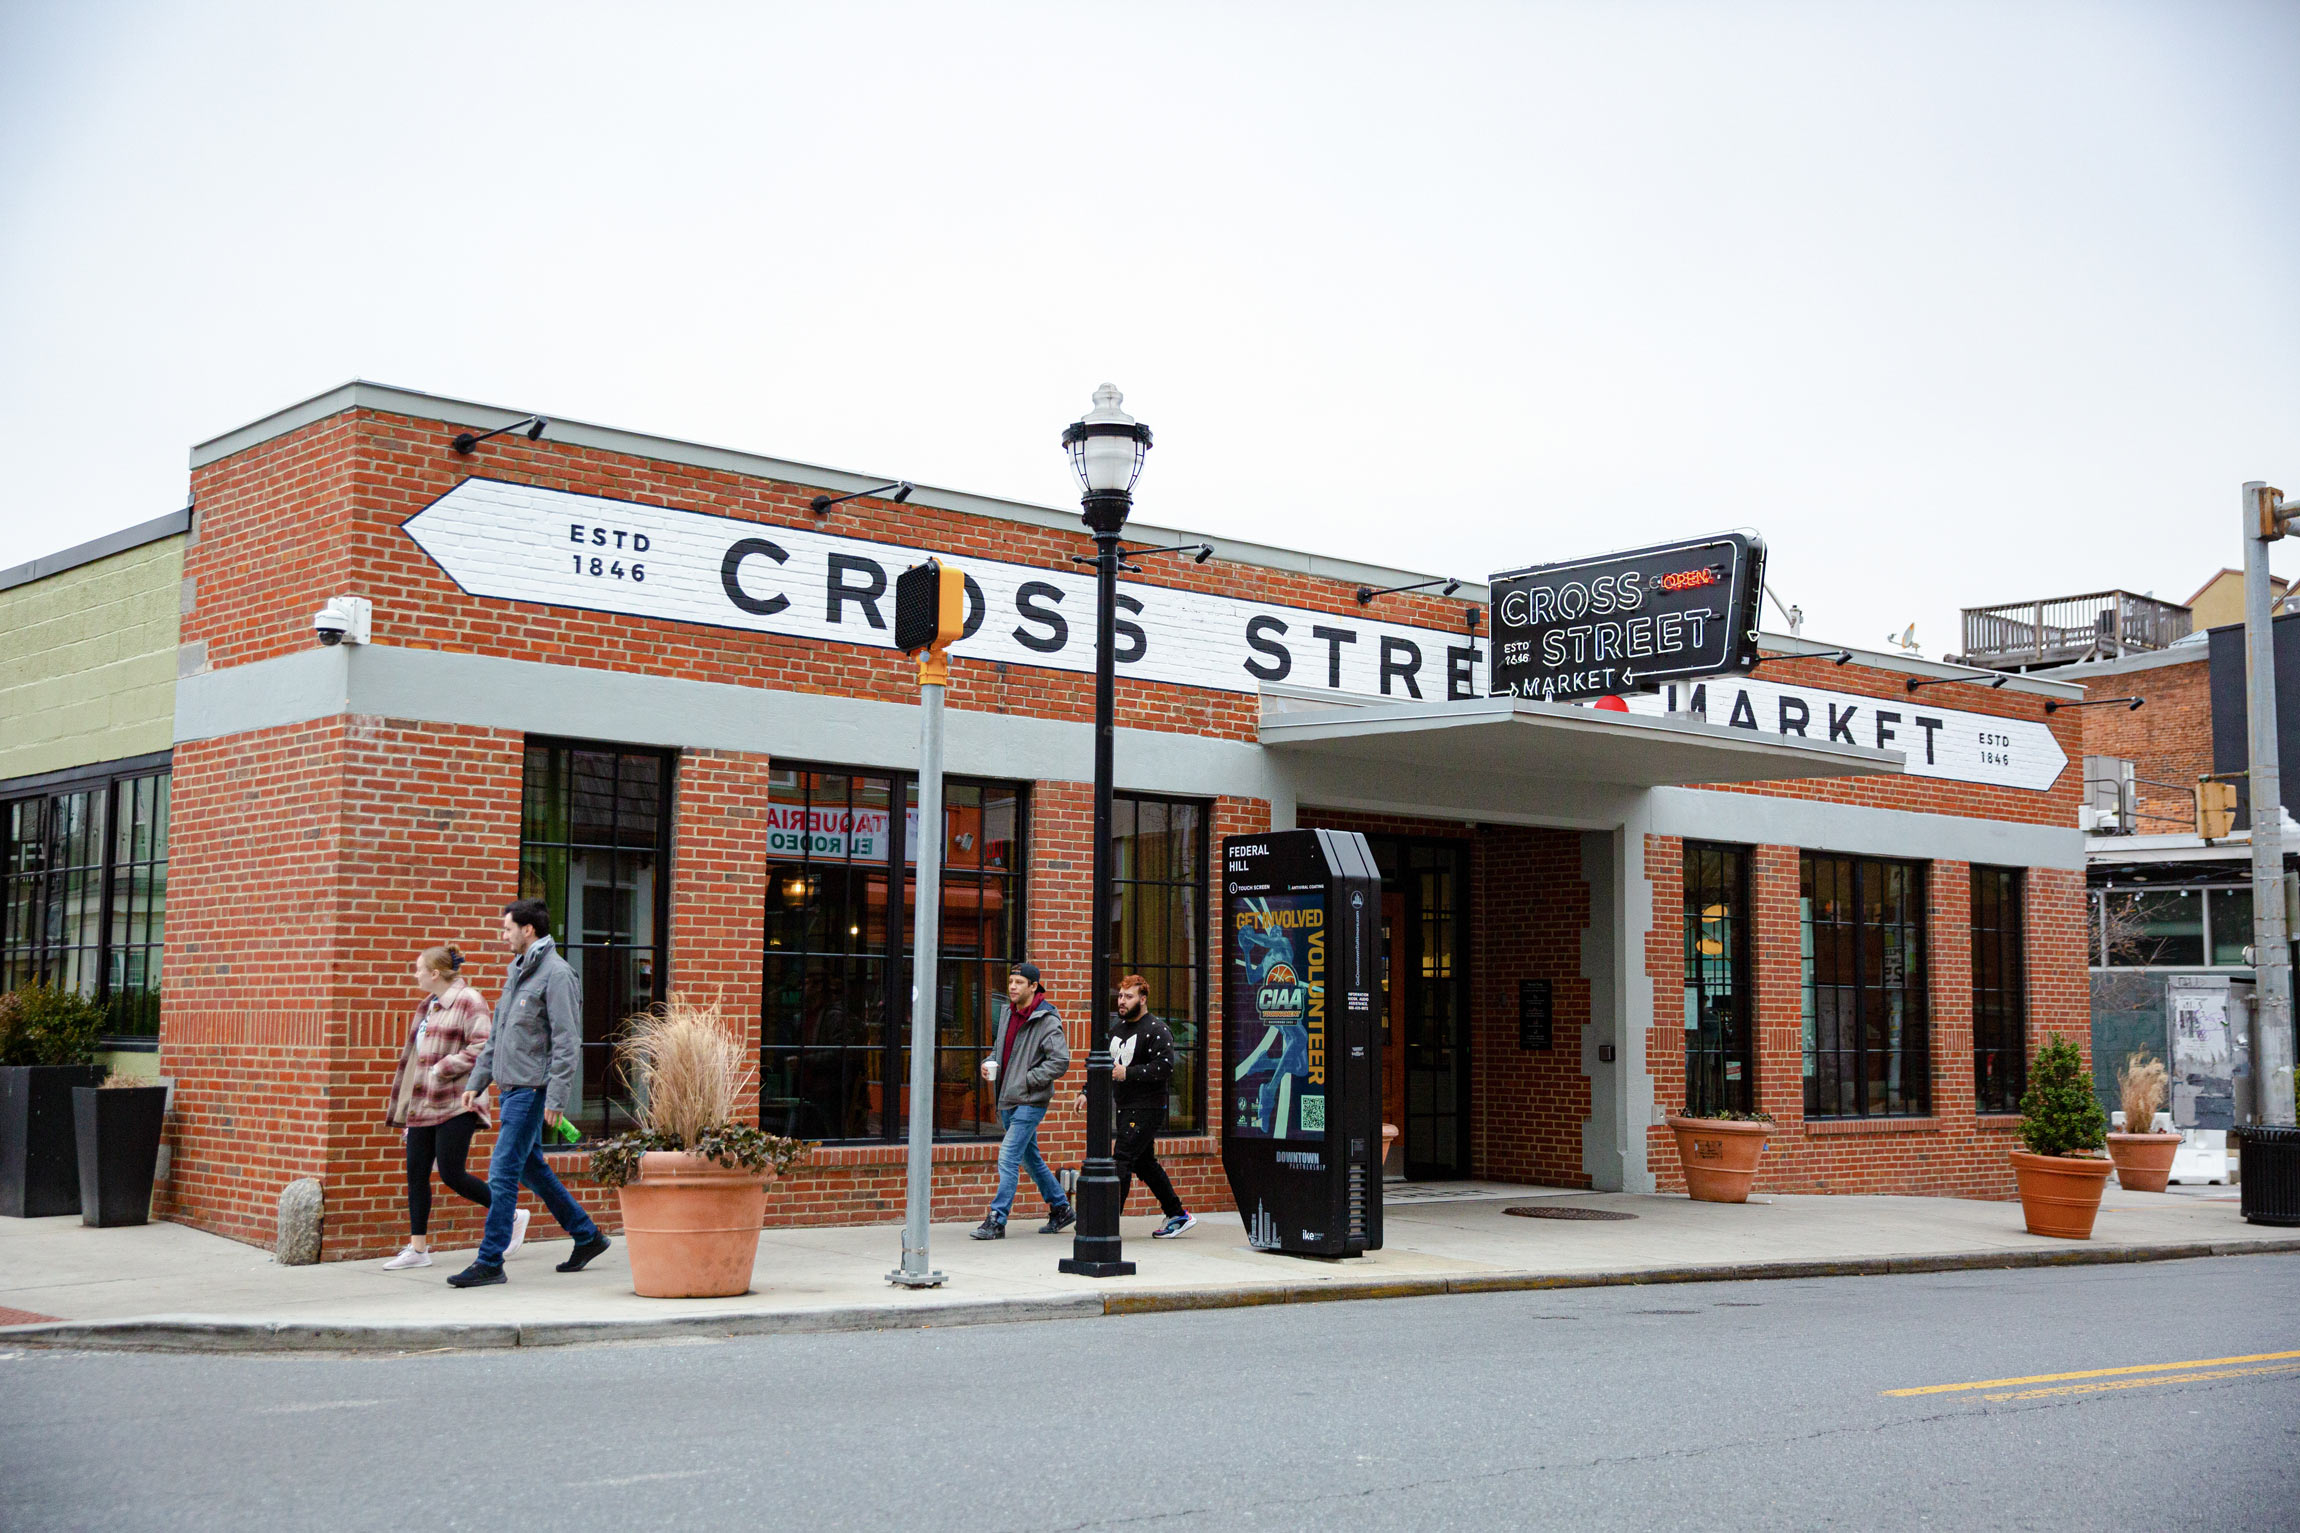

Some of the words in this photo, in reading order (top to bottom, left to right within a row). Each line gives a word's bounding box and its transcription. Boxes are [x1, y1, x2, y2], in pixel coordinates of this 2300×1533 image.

[570, 523, 651, 553] ESTD
[572, 554, 647, 583] 1846
[1664, 570, 1709, 590] OPEN
[1501, 571, 1643, 628] CROSS
[1504, 641, 1530, 654] ESTD
[1542, 608, 1712, 667] STREET
[1243, 614, 1485, 702] STRE
[1523, 667, 1616, 697] MARKET
[1979, 732, 2010, 748] ESTD
[1980, 751, 2009, 766] 1846
[1229, 844, 1270, 858] FEDERAL
[1229, 860, 1249, 872] HILL
[1236, 911, 1261, 930] GET
[1262, 908, 1324, 929] INVOLVED
[1259, 988, 1303, 1010] CIAA
[1307, 929, 1325, 1085] VOLUNTEER
[1276, 1151, 1320, 1164] DOWNTOWN
[1289, 1163, 1326, 1171] PARTNERSHIP
[1302, 1229, 1315, 1241] ike
